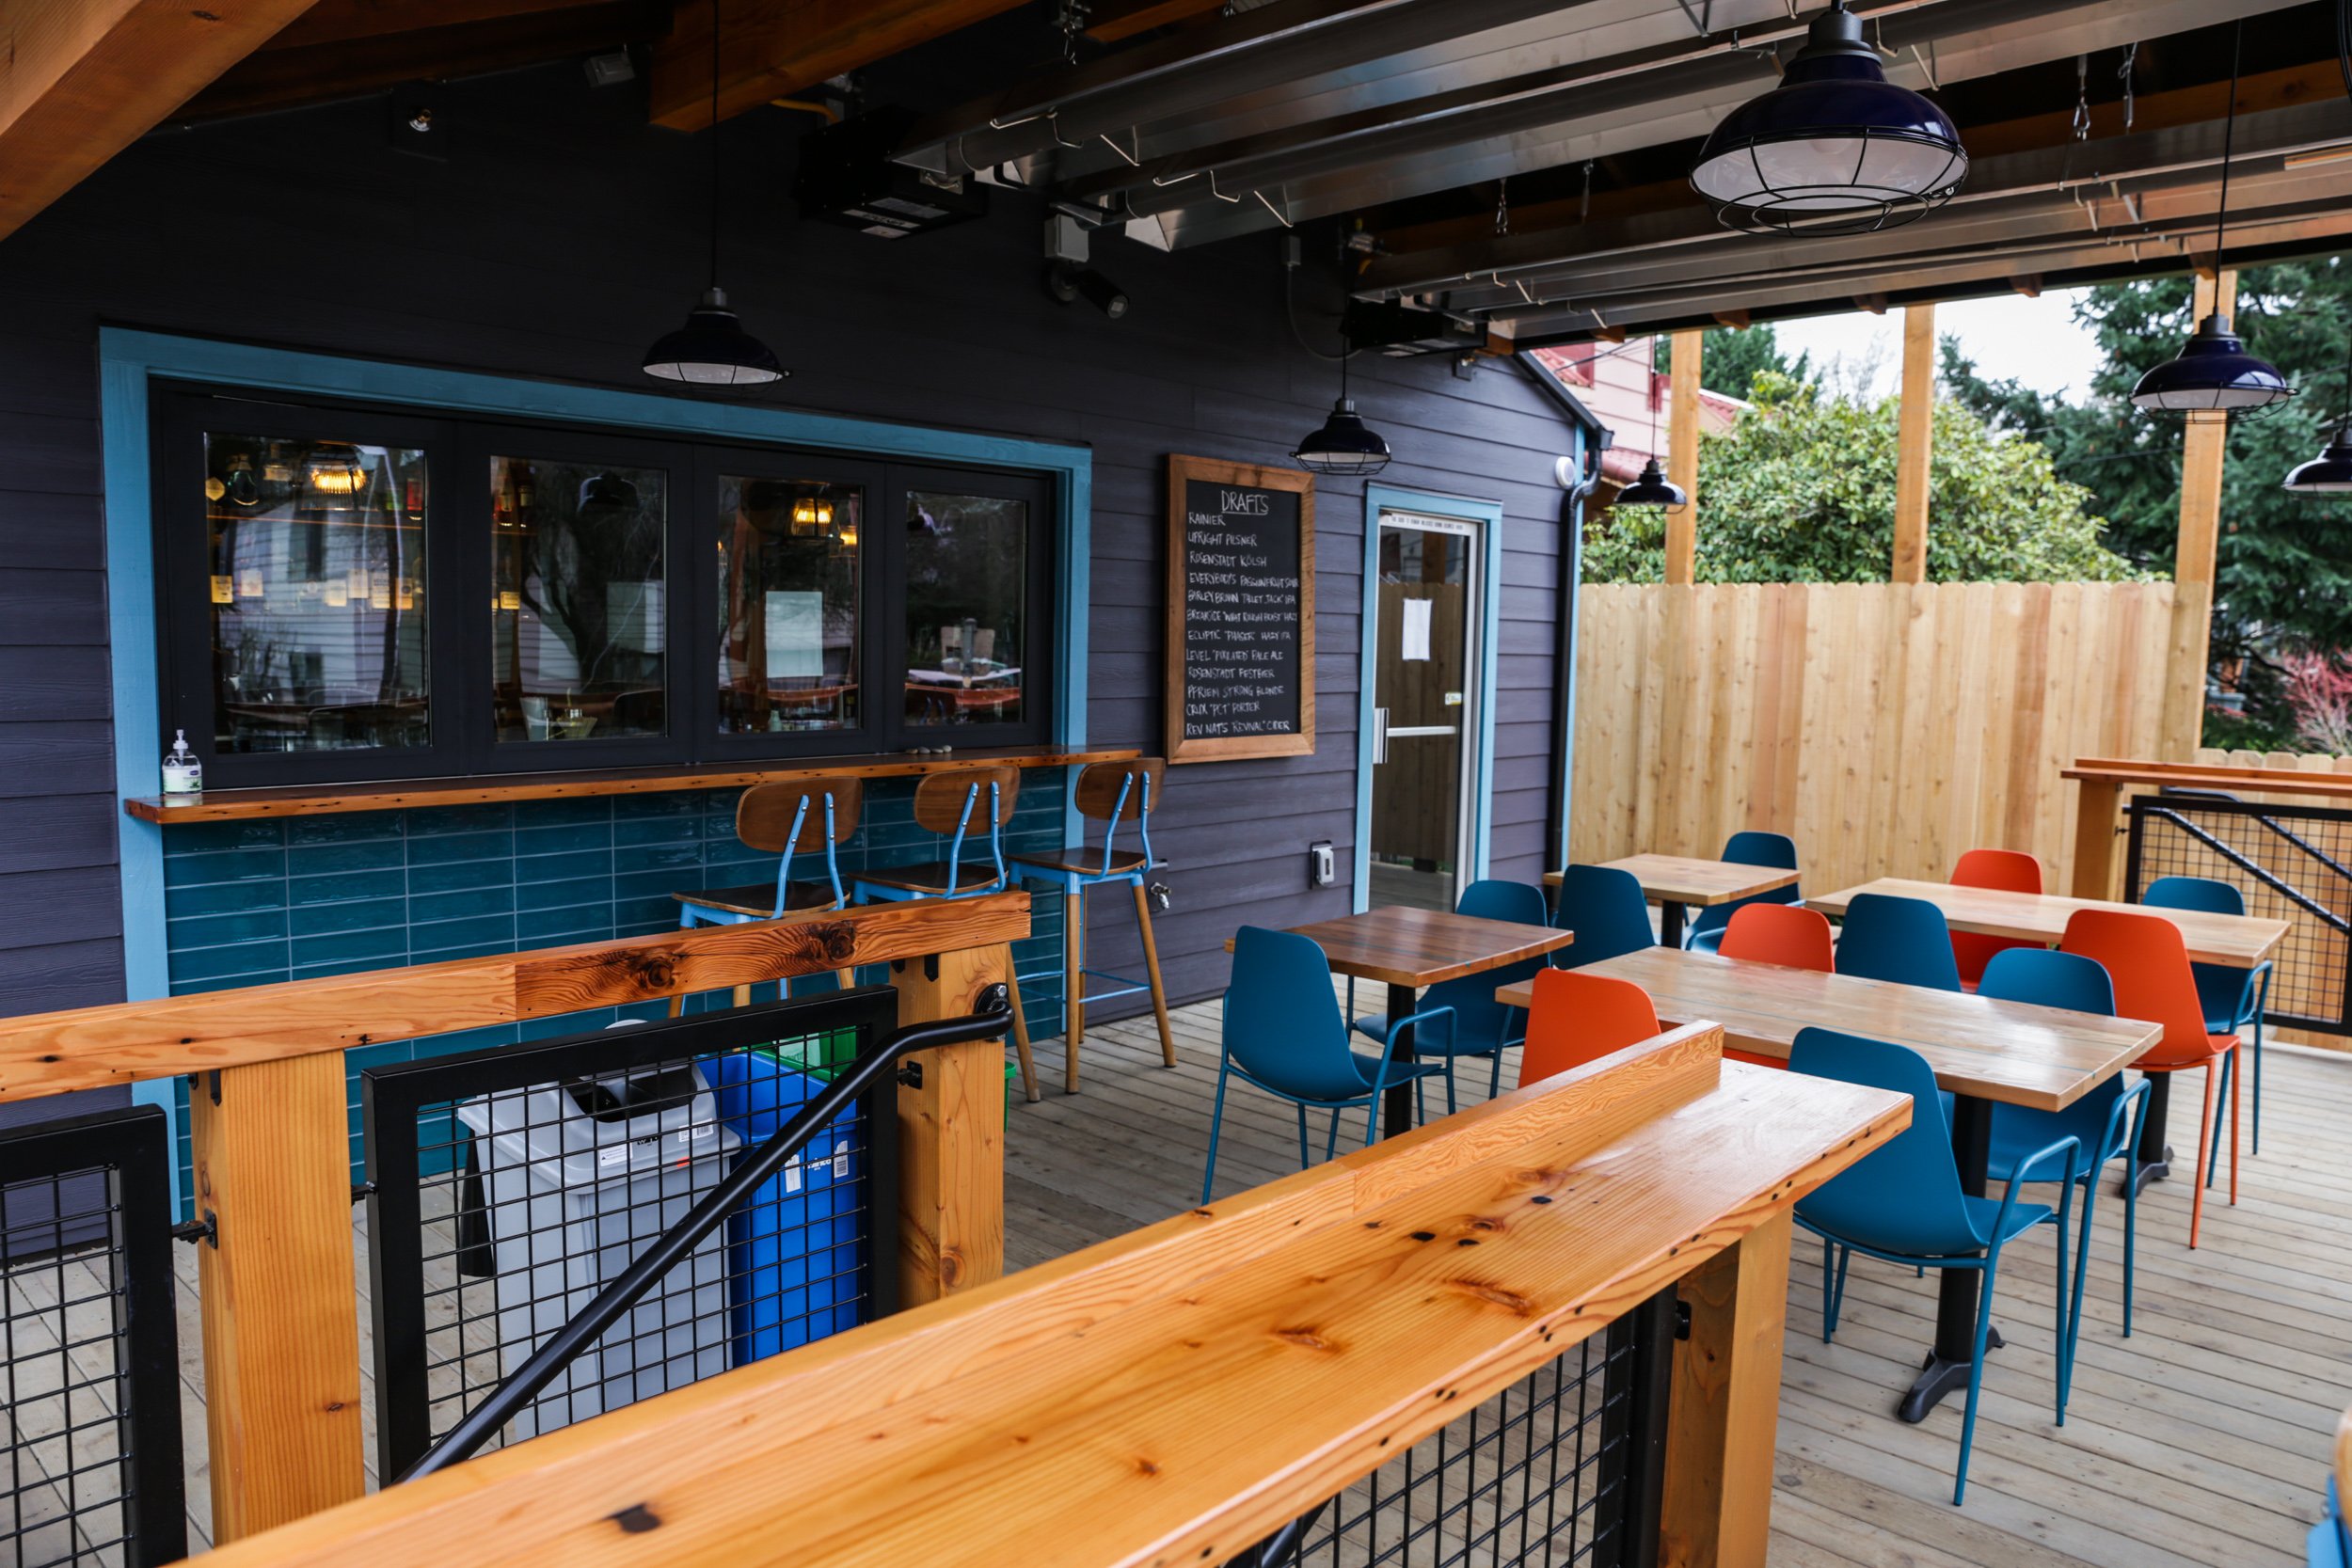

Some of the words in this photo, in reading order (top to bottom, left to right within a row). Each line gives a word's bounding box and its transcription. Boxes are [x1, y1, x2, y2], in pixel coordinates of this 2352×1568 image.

[1221, 490, 1269, 514] DRAFTS
[1188, 512, 1226, 526] RAINIER
[1188, 531, 1223, 546] UPRIGHT
[1226, 533, 1258, 546] PILSNER
[1186, 648, 1211, 661] LEVEL
[1222, 685, 1253, 698] STRONG
[1232, 701, 1261, 714] PORTER
[1186, 722, 1203, 736] REV
